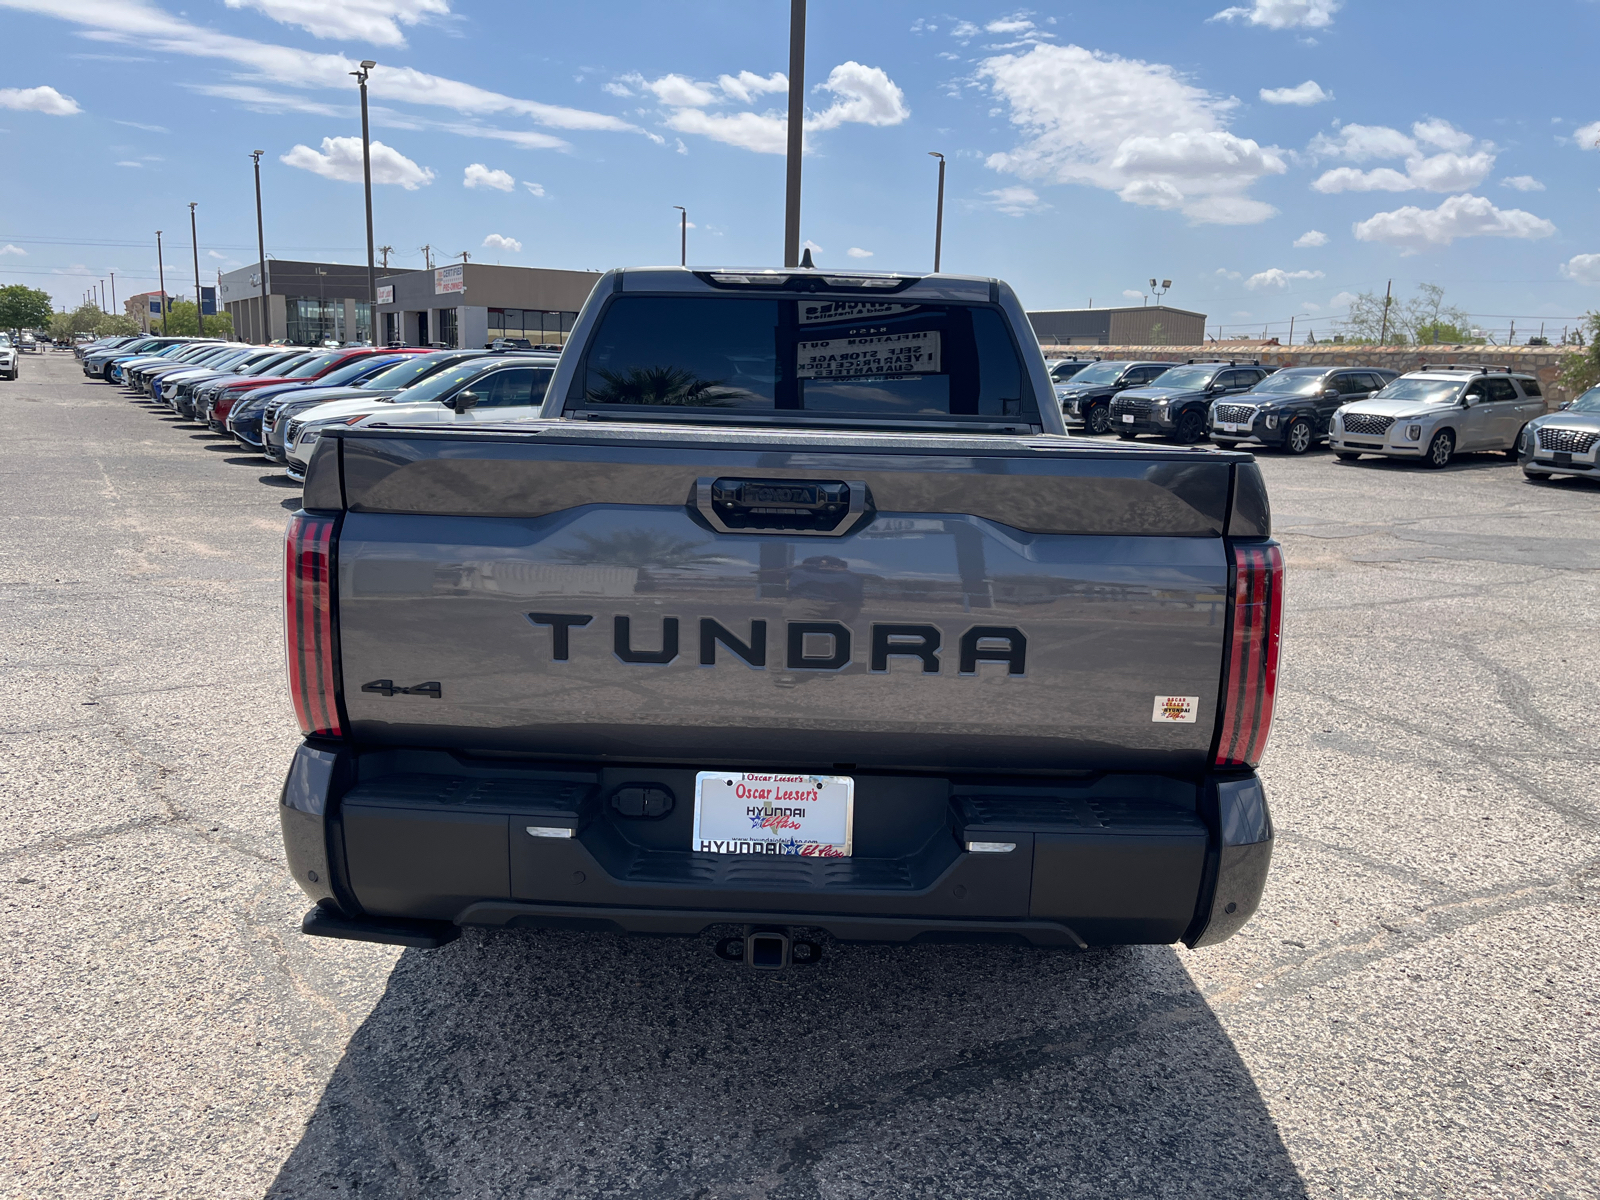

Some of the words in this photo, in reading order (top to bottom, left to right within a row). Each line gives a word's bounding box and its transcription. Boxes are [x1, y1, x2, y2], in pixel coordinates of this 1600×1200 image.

[443, 267, 463, 278] CERTIFIED
[443, 281, 463, 292] PRE-OWNED
[750, 487, 812, 502] TOYOTA
[525, 612, 1028, 676] TUNDRA
[746, 773, 772, 781] Oscar
[773, 775, 803, 783] Leeser's
[735, 783, 772, 800] Oscar
[774, 786, 819, 802] Leeser's
[746, 806, 806, 818] HYUNDAI
[775, 815, 801, 830] Paso
[700, 839, 782, 855] HYUNDAI
[801, 844, 820, 857] El
[818, 844, 845, 858] Paso
